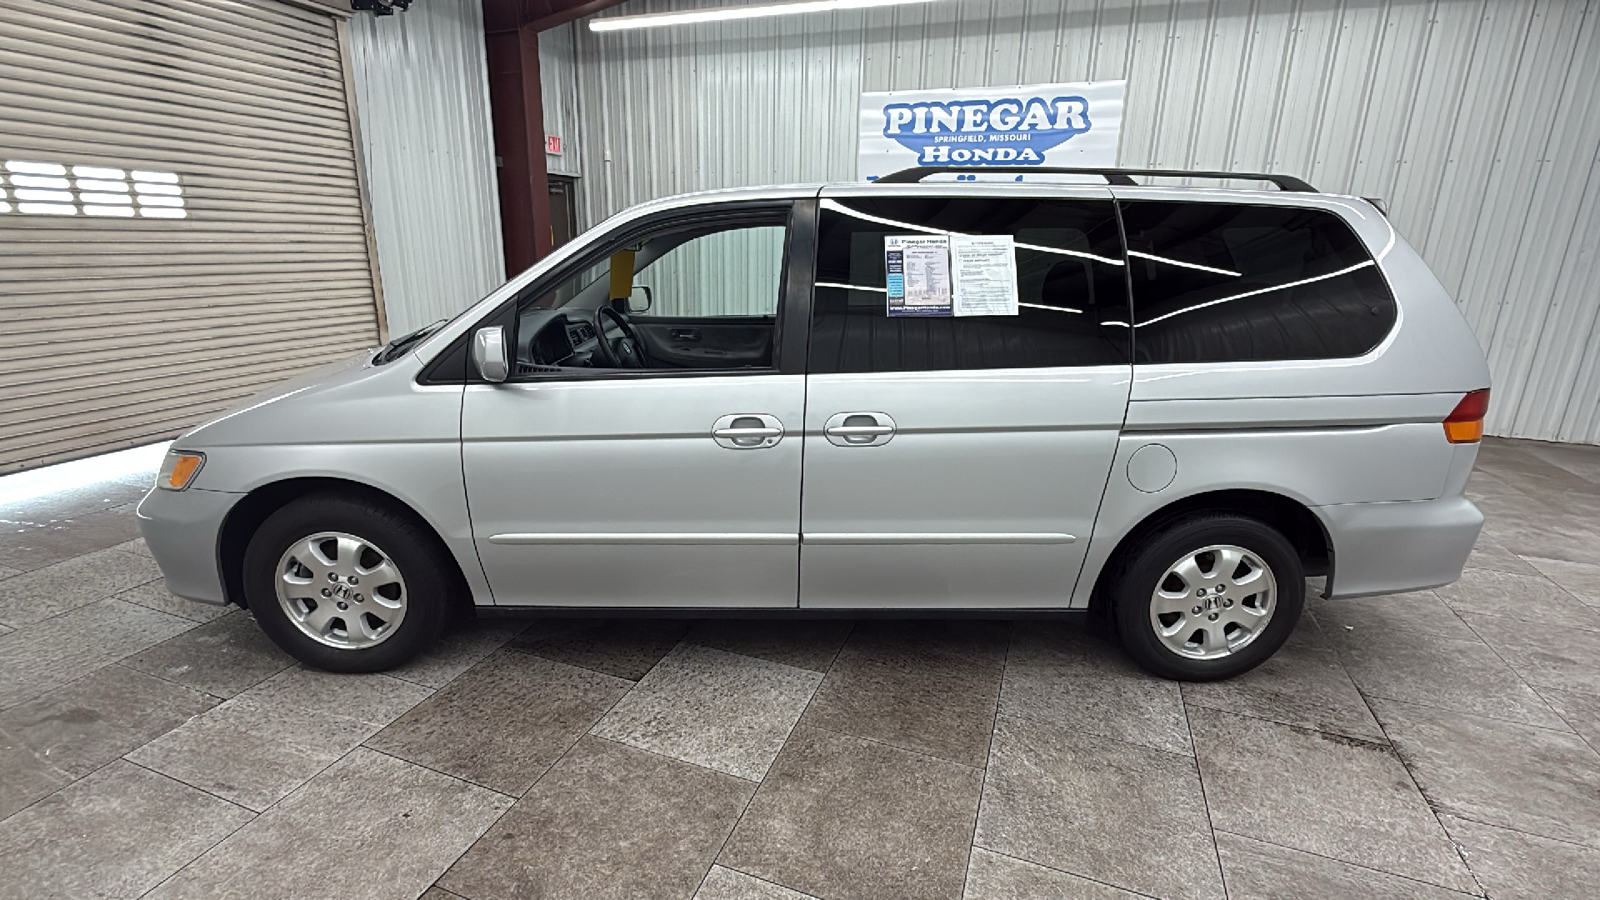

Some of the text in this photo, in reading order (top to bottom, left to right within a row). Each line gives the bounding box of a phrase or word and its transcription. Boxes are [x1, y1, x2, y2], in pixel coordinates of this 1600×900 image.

[886, 100, 1088, 134] PINEGAR
[548, 135, 560, 153] EXIT
[933, 133, 1031, 144] SPRINGFIELD, MISSOURI
[921, 146, 1040, 163] HONDA
